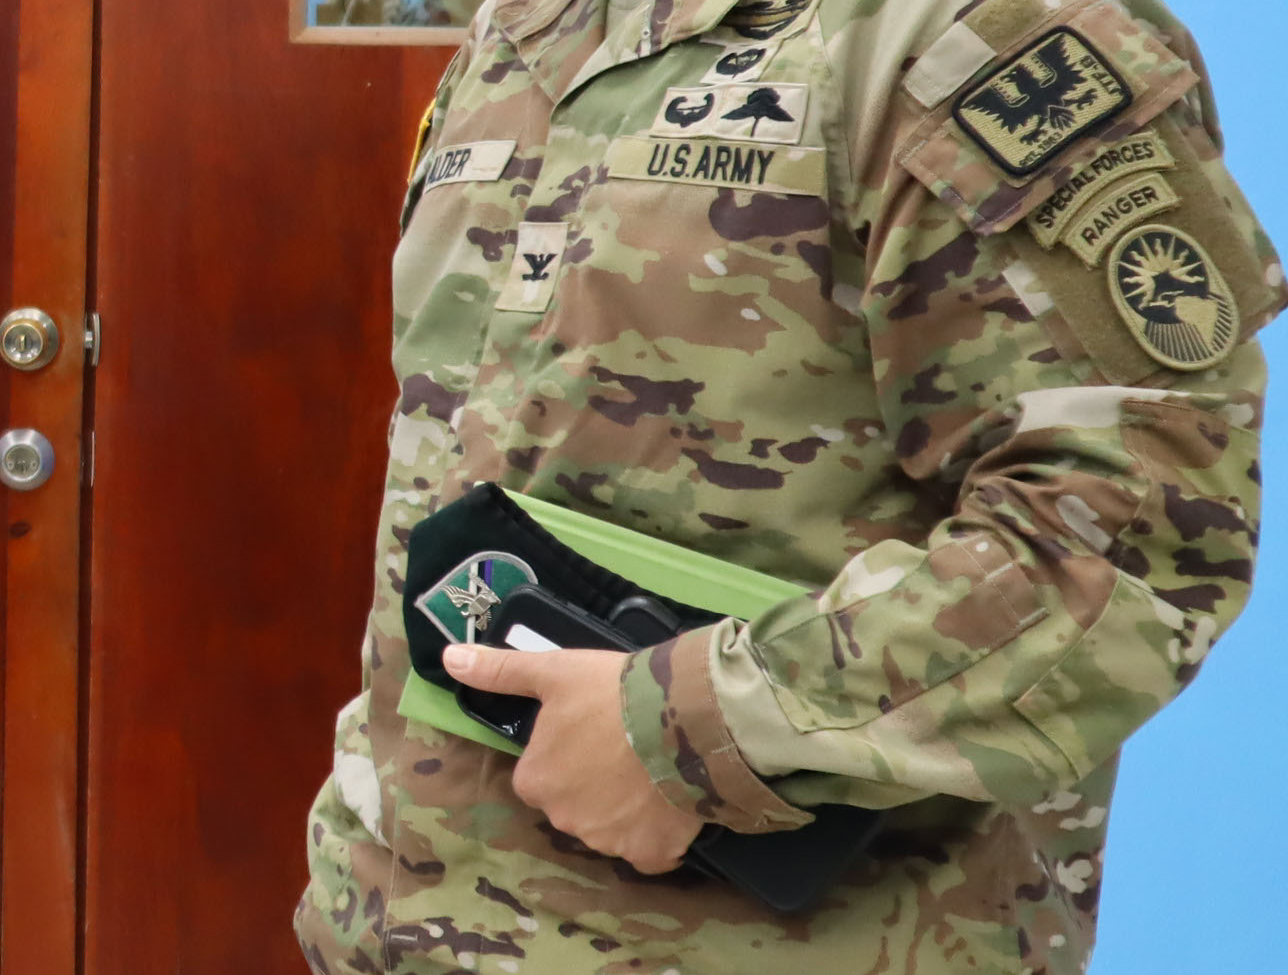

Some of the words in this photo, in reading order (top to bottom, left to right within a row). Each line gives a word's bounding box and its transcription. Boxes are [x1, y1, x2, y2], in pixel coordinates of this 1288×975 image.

[1035, 170, 1097, 229] SPECIAL
[1090, 141, 1155, 176] FORCES
[1080, 185, 1160, 247] RANGER
